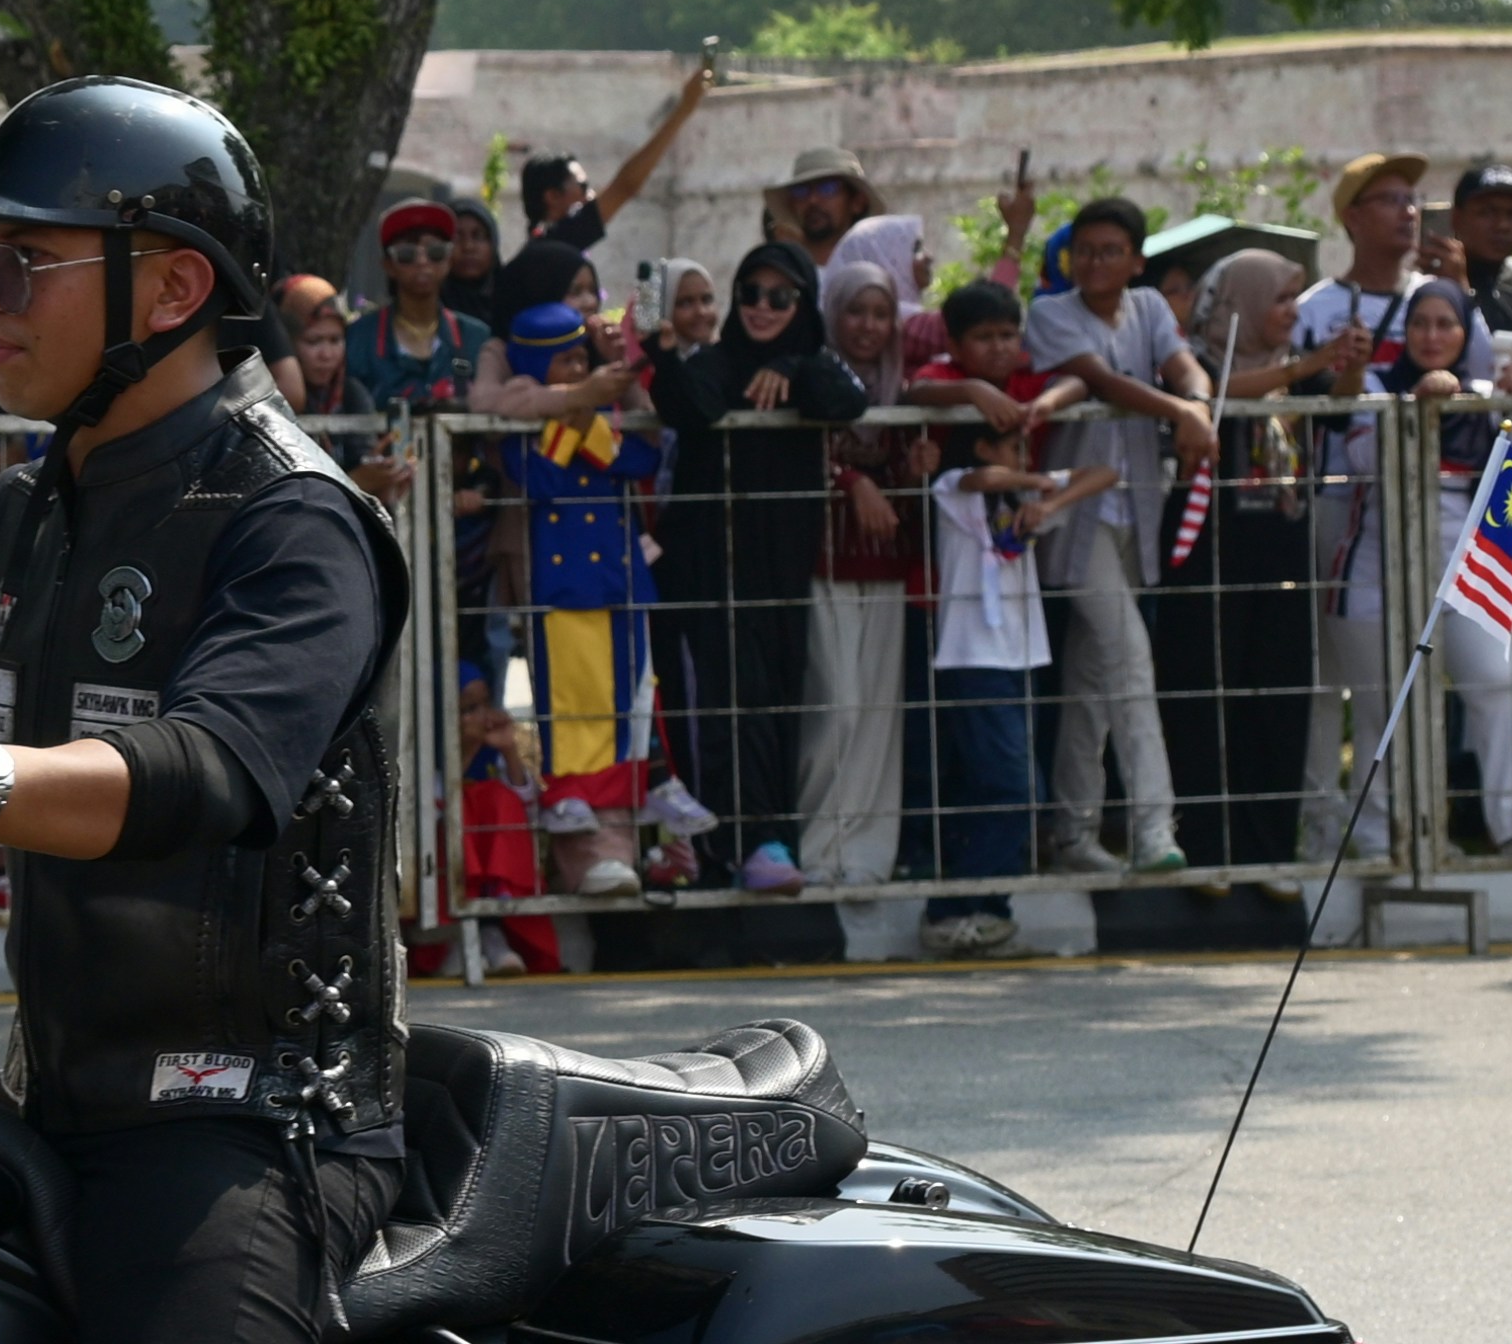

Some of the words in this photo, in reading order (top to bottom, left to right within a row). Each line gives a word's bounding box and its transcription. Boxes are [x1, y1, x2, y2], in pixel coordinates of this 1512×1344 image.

[77, 691, 130, 715] SKYHAWK
[132, 697, 155, 718] MC
[158, 1054, 201, 1067] FIRST
[203, 1054, 251, 1069] BLOOD
